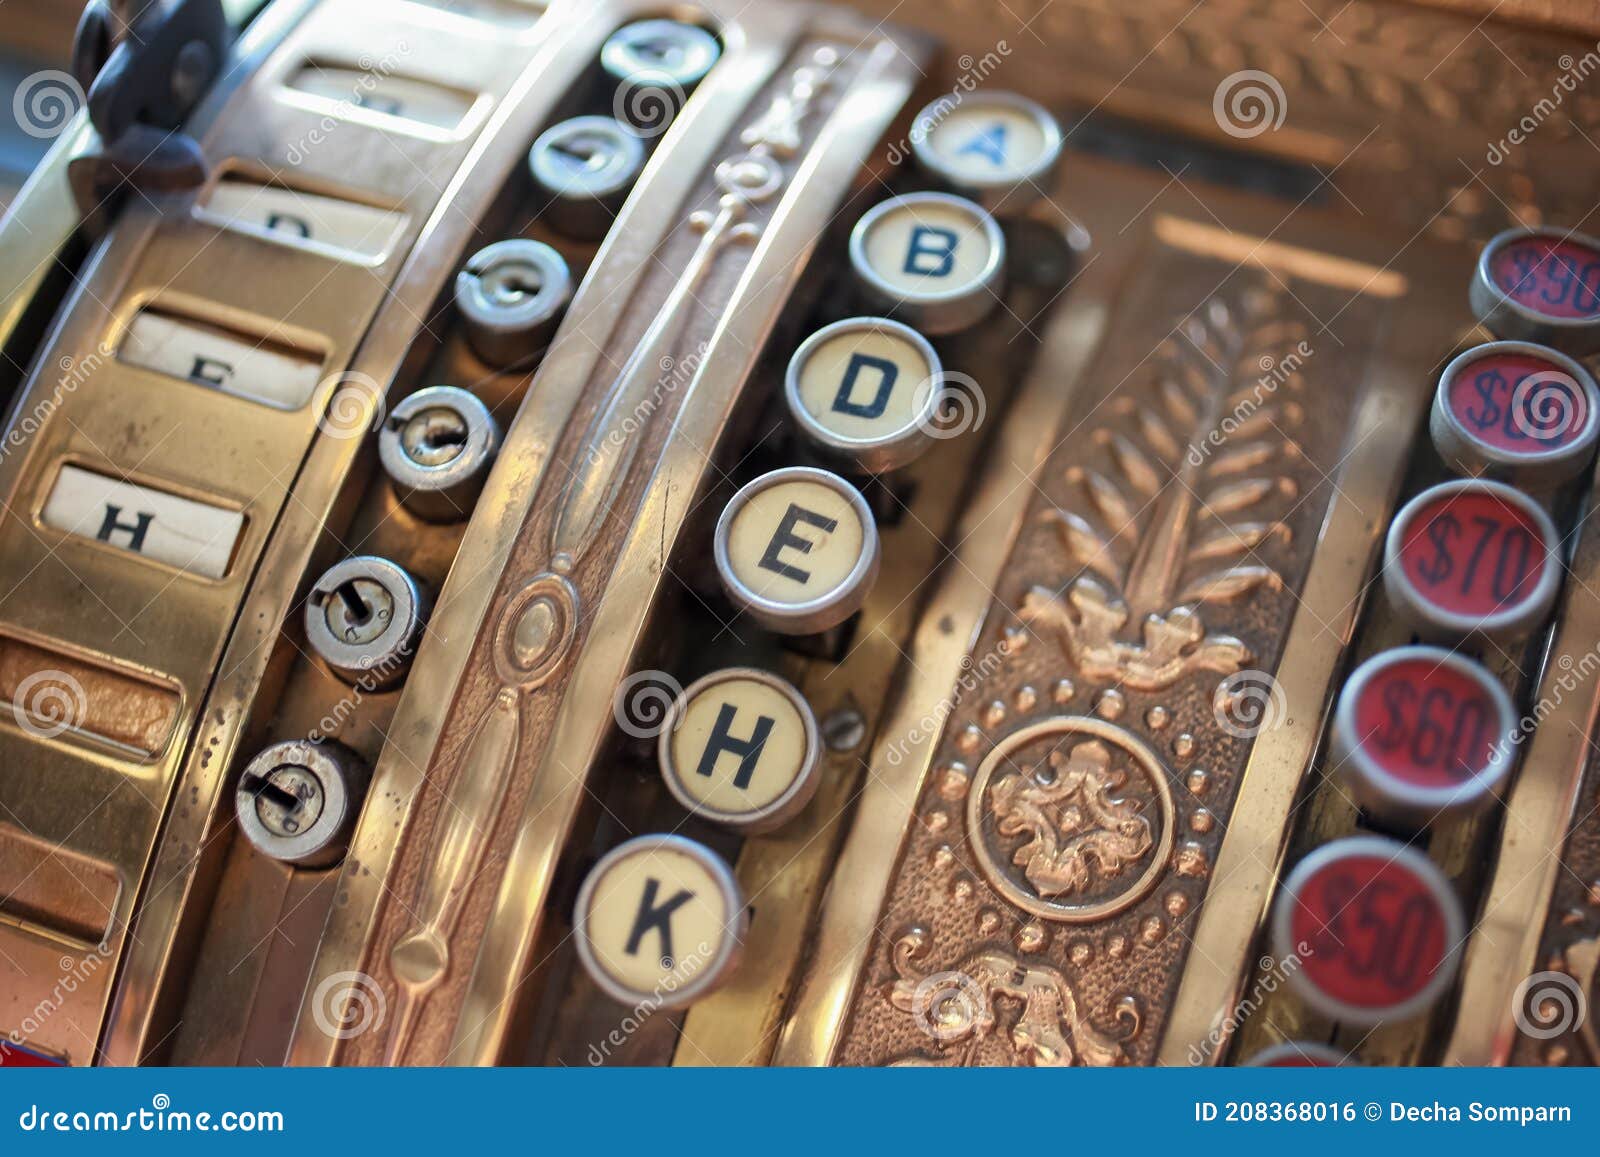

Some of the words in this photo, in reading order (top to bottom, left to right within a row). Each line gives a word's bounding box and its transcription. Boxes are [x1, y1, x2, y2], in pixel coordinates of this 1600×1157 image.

[955, 123, 1006, 167] A
[902, 226, 959, 277] B
[831, 352, 900, 420] D
[97, 503, 156, 552] H
[757, 503, 838, 585] E
[1417, 511, 1532, 602] $70
[696, 702, 775, 790] H
[1374, 680, 1491, 780] $60
[623, 877, 696, 970] K
